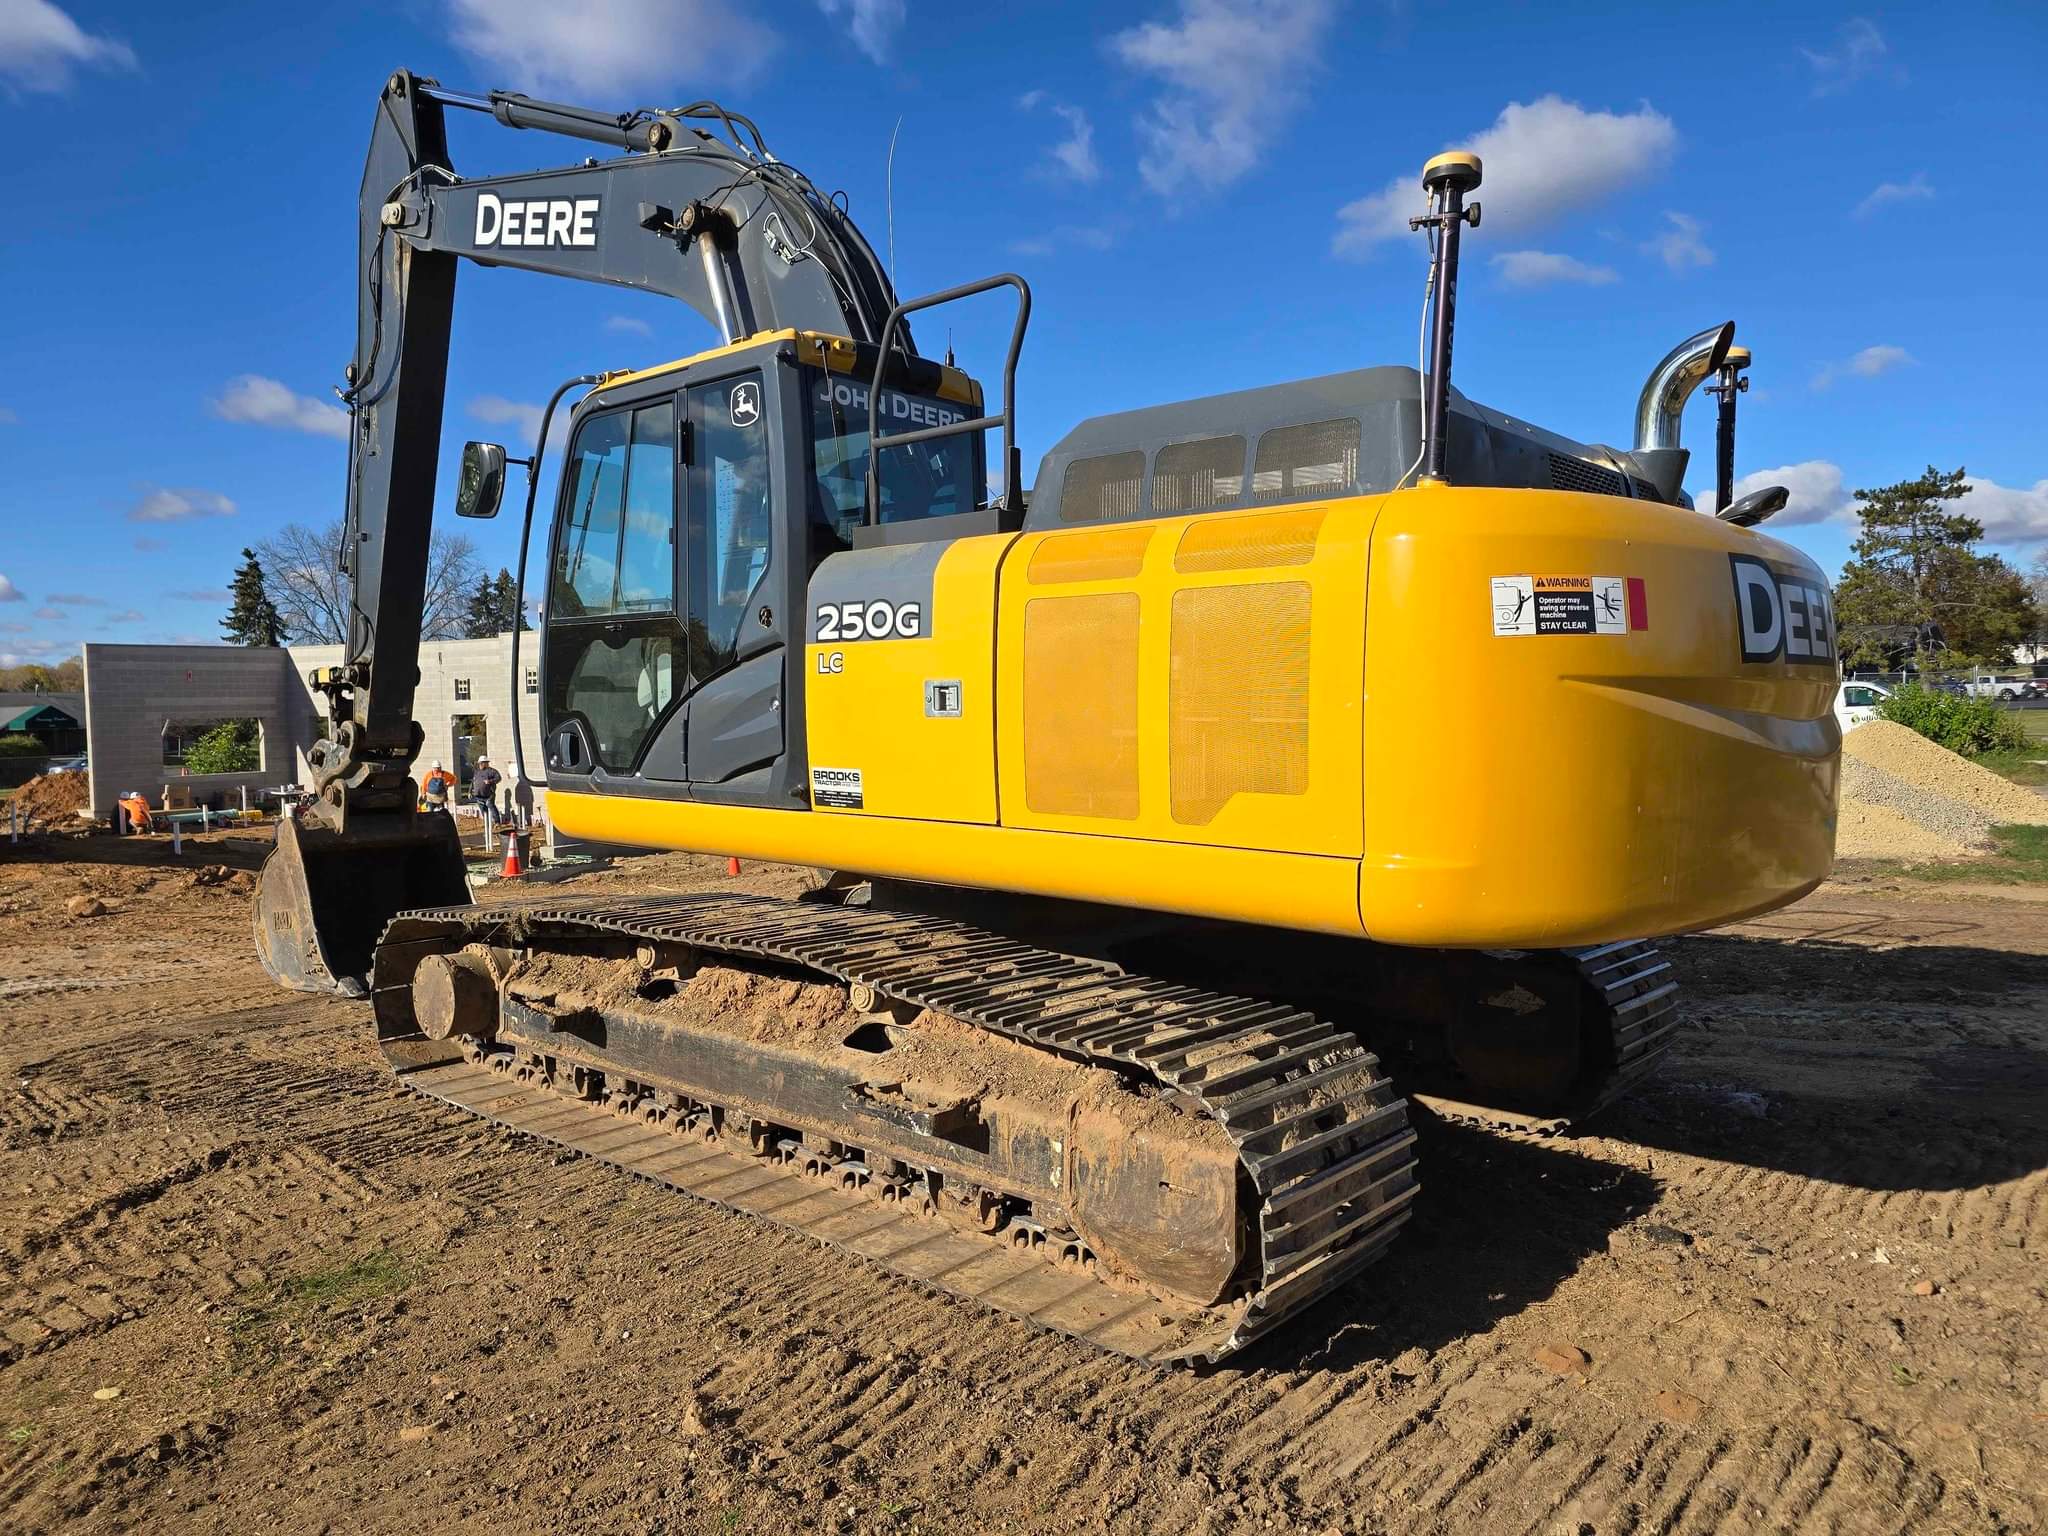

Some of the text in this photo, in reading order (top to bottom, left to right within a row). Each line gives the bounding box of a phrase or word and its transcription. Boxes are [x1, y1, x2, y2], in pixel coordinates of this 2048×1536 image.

[474, 193, 600, 247] DEERE
[1546, 577, 1590, 588] WARNING
[1538, 597, 1567, 605] Operator
[1539, 604, 1559, 612] swing
[817, 600, 920, 641] 250G
[1540, 611, 1567, 619] machine
[1540, 621, 1588, 630] STAY CLEAR
[818, 652, 843, 673] LC
[813, 769, 860, 782] BROOKS
